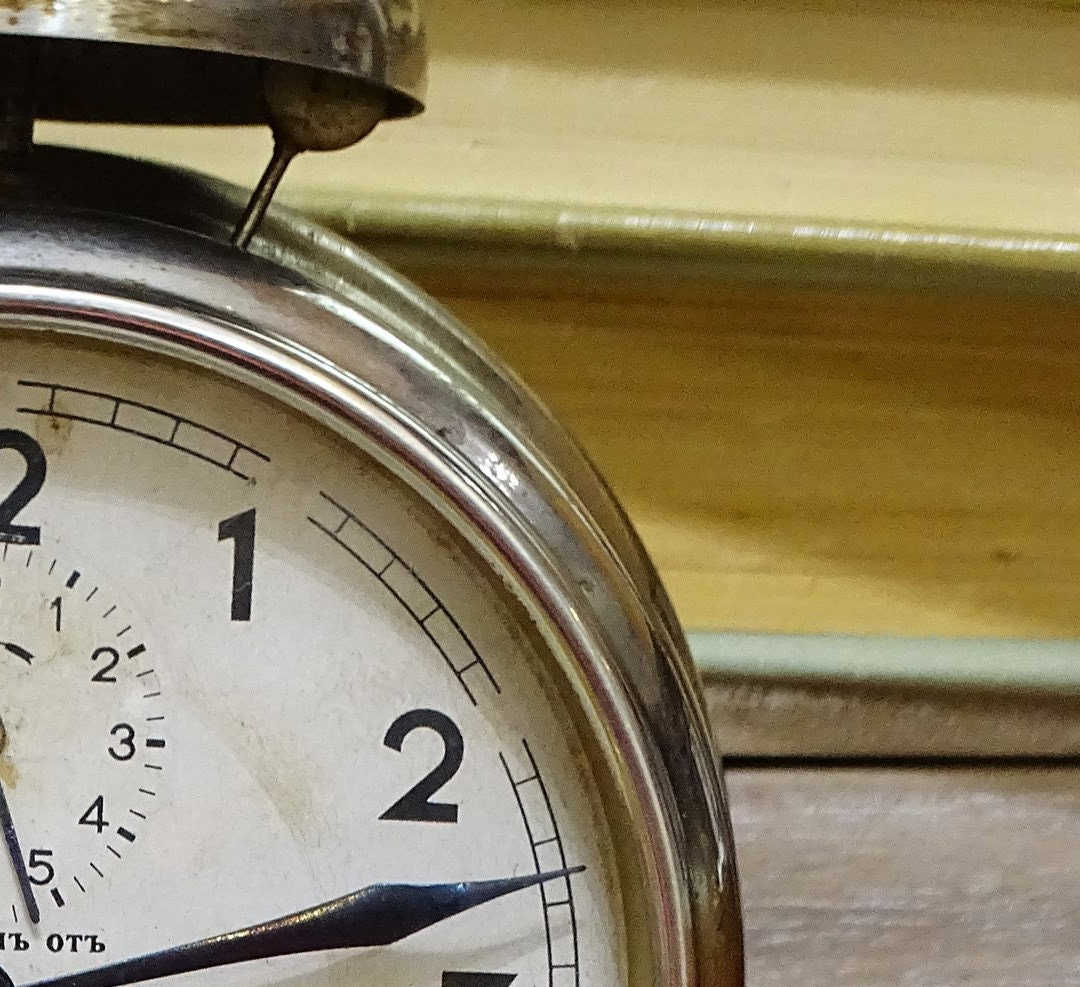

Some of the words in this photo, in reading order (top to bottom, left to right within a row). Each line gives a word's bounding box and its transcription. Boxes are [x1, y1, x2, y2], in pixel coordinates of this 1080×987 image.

[217, 506, 257, 622] 1
[49, 596, 63, 633] 1
[91, 646, 120, 683] 2
[107, 723, 136, 760] 3
[377, 708, 465, 824] 2
[78, 794, 110, 834] 4
[29, 848, 55, 886] 5
[46, 933, 106, 954] отъ
